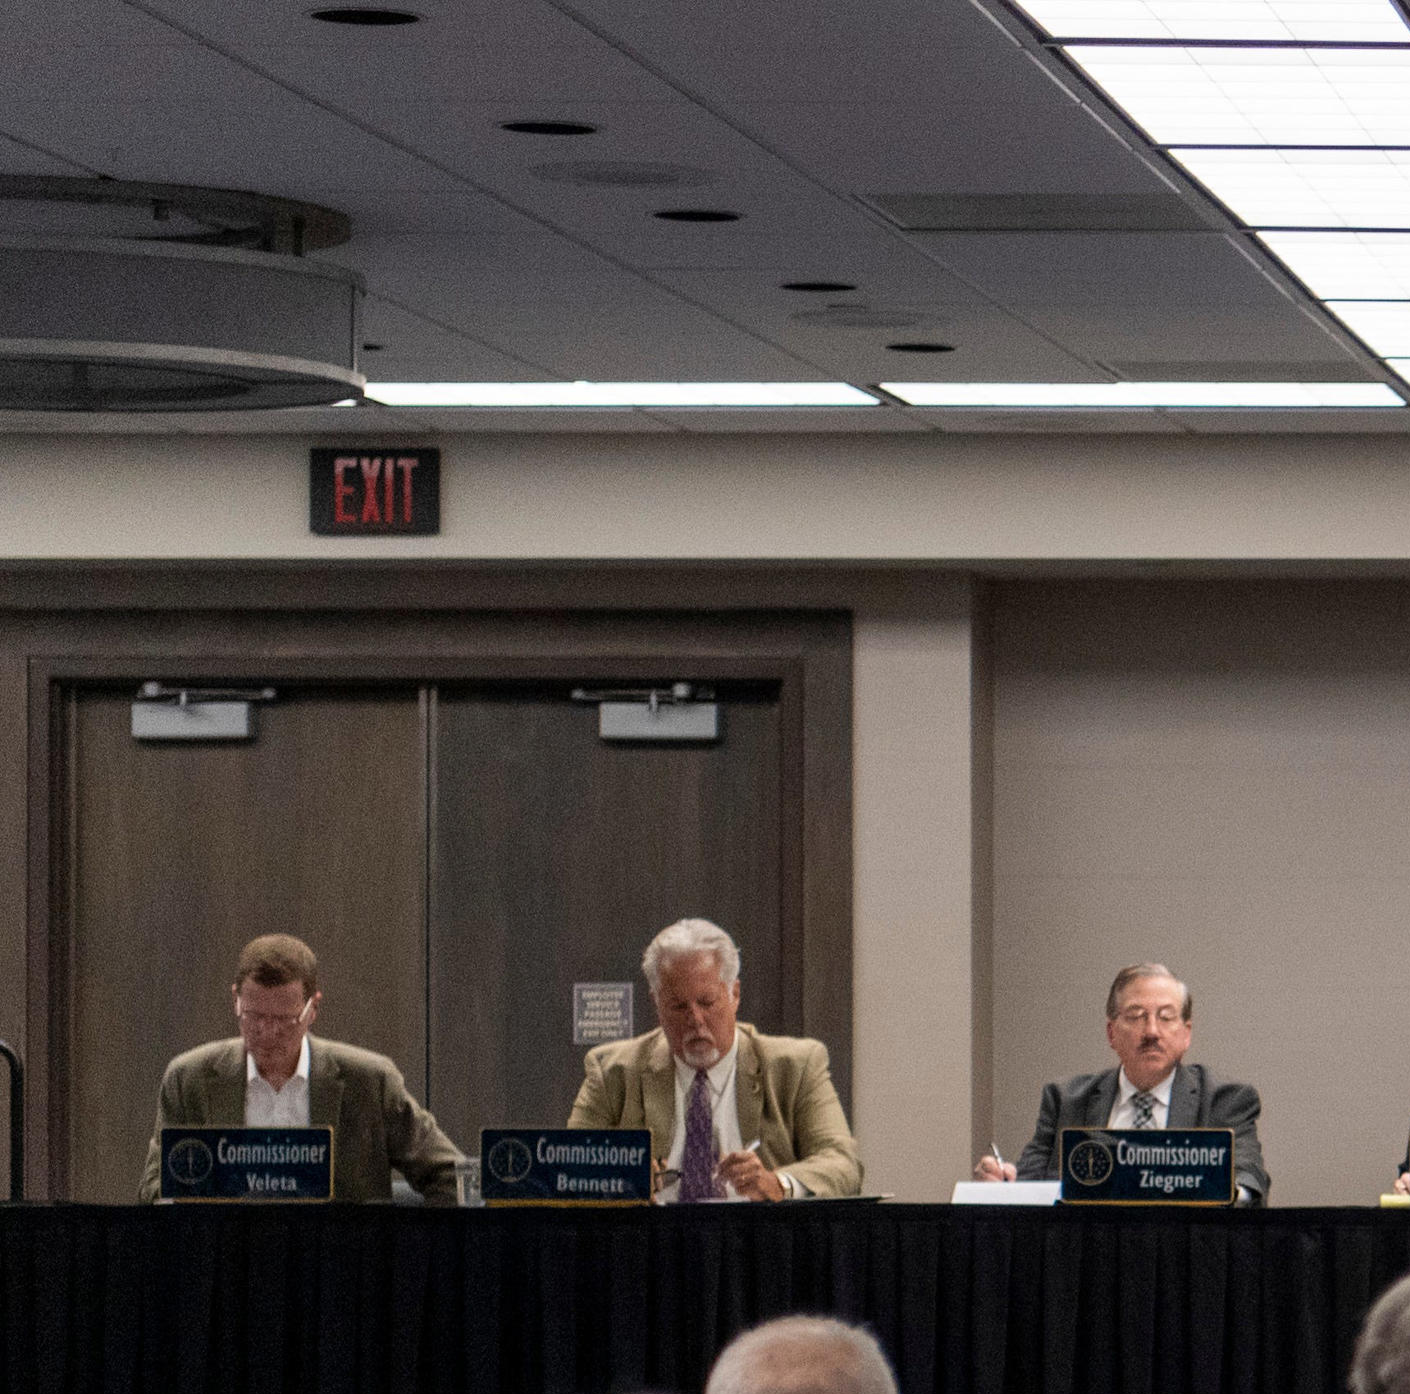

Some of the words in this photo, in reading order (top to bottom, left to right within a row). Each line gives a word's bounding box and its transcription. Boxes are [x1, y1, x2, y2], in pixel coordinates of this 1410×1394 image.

[334, 457, 419, 523] EXIT
[217, 1136, 327, 1165] Commissioner
[537, 1136, 646, 1166] Commissioner
[1117, 1139, 1226, 1166] Commissioner
[246, 1173, 297, 1191] Veleta
[556, 1172, 624, 1193] Bennett
[1139, 1170, 1203, 1193] Ziegner
